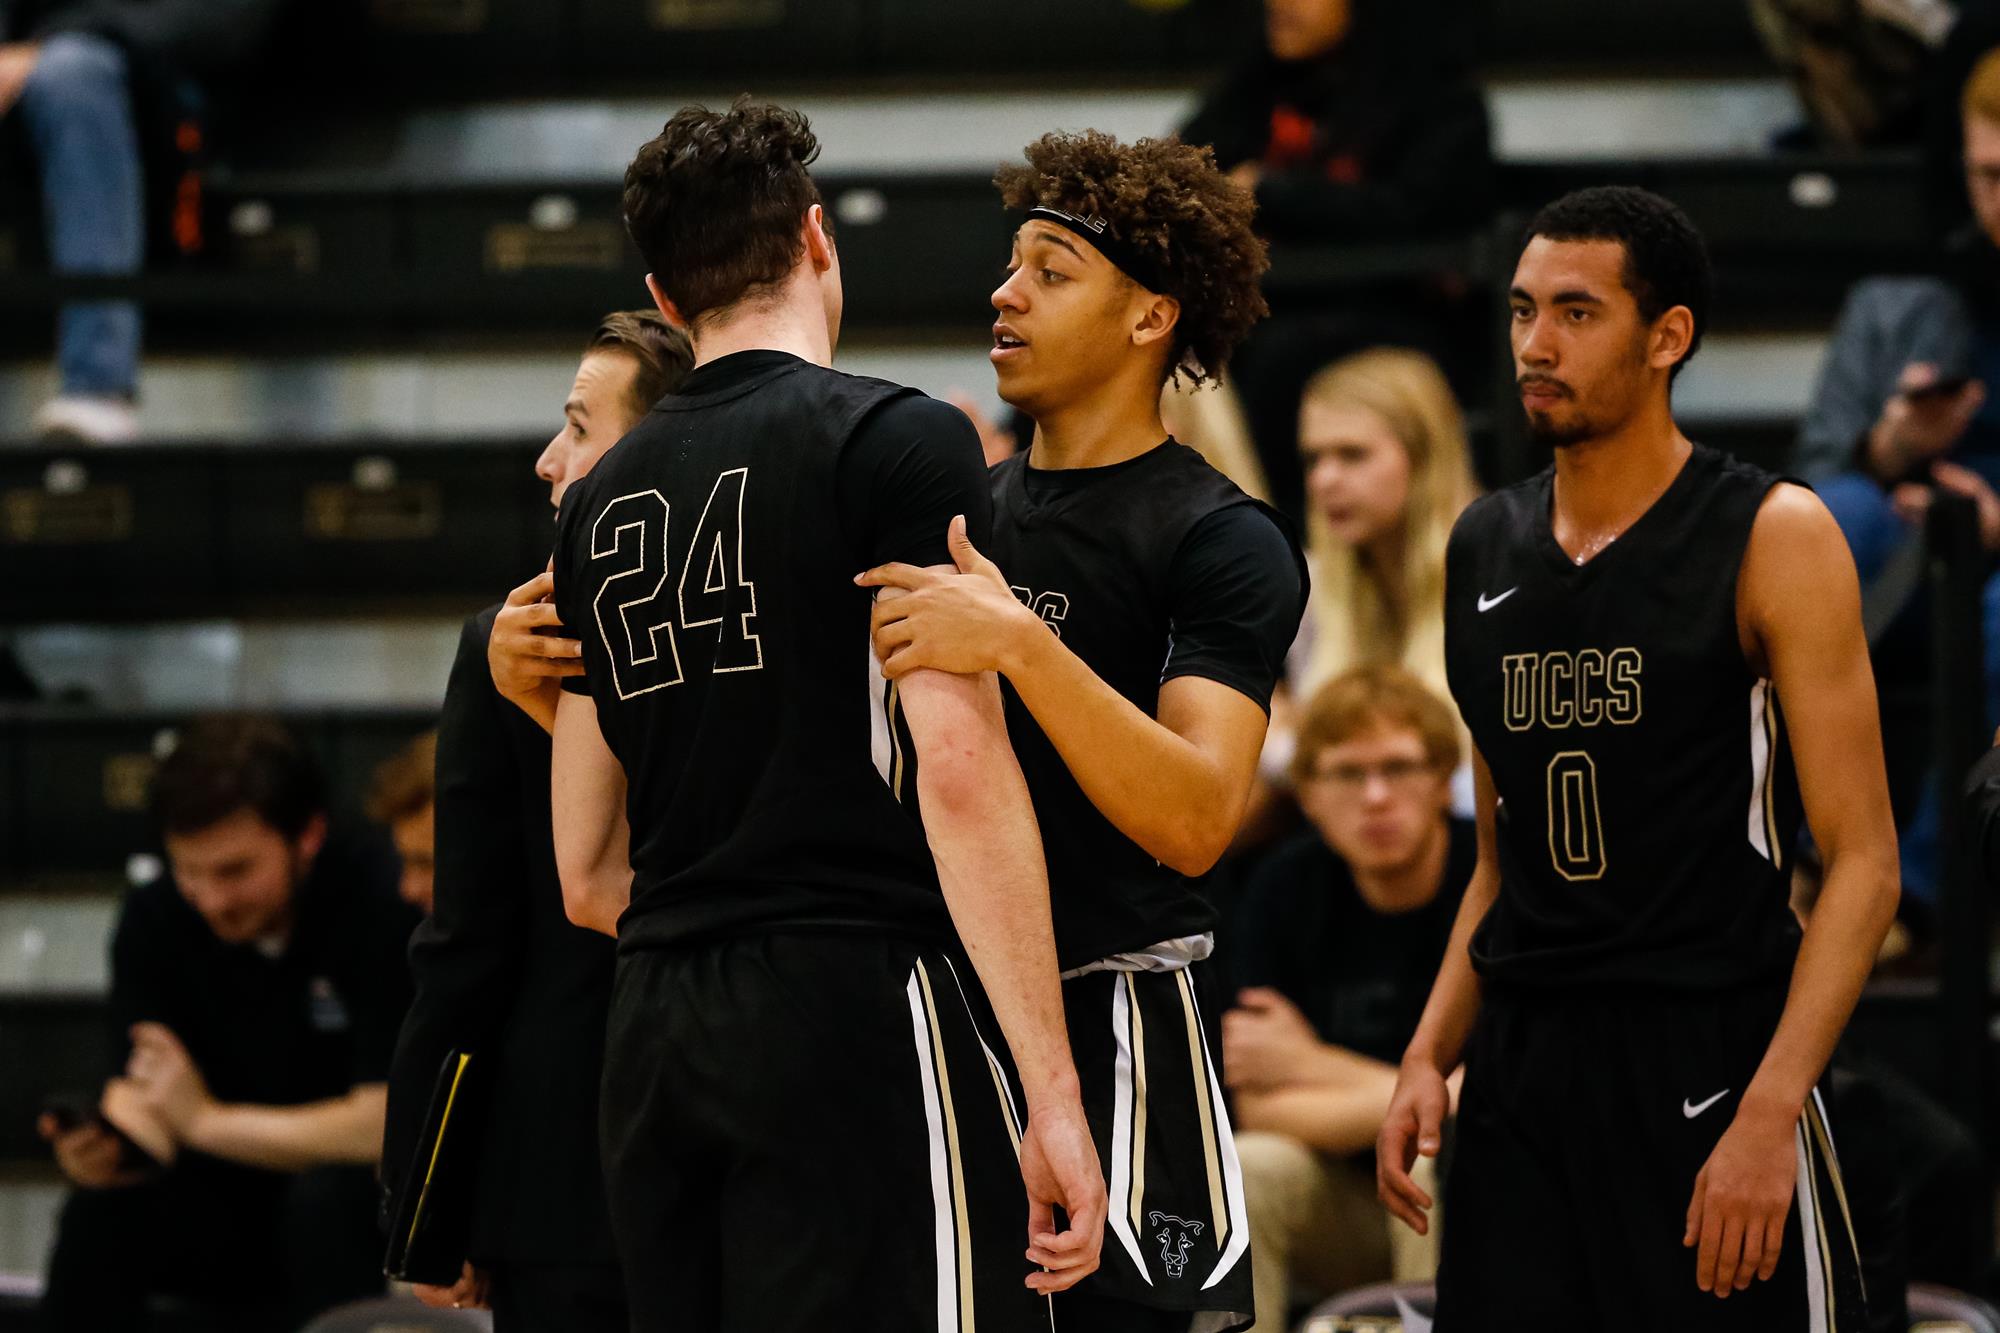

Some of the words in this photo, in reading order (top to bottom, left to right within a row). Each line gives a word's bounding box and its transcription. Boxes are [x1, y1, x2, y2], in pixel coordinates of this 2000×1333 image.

[591, 467, 763, 700] 24
[1502, 647, 1642, 731] UCCS
[1547, 750, 1607, 882] 0
